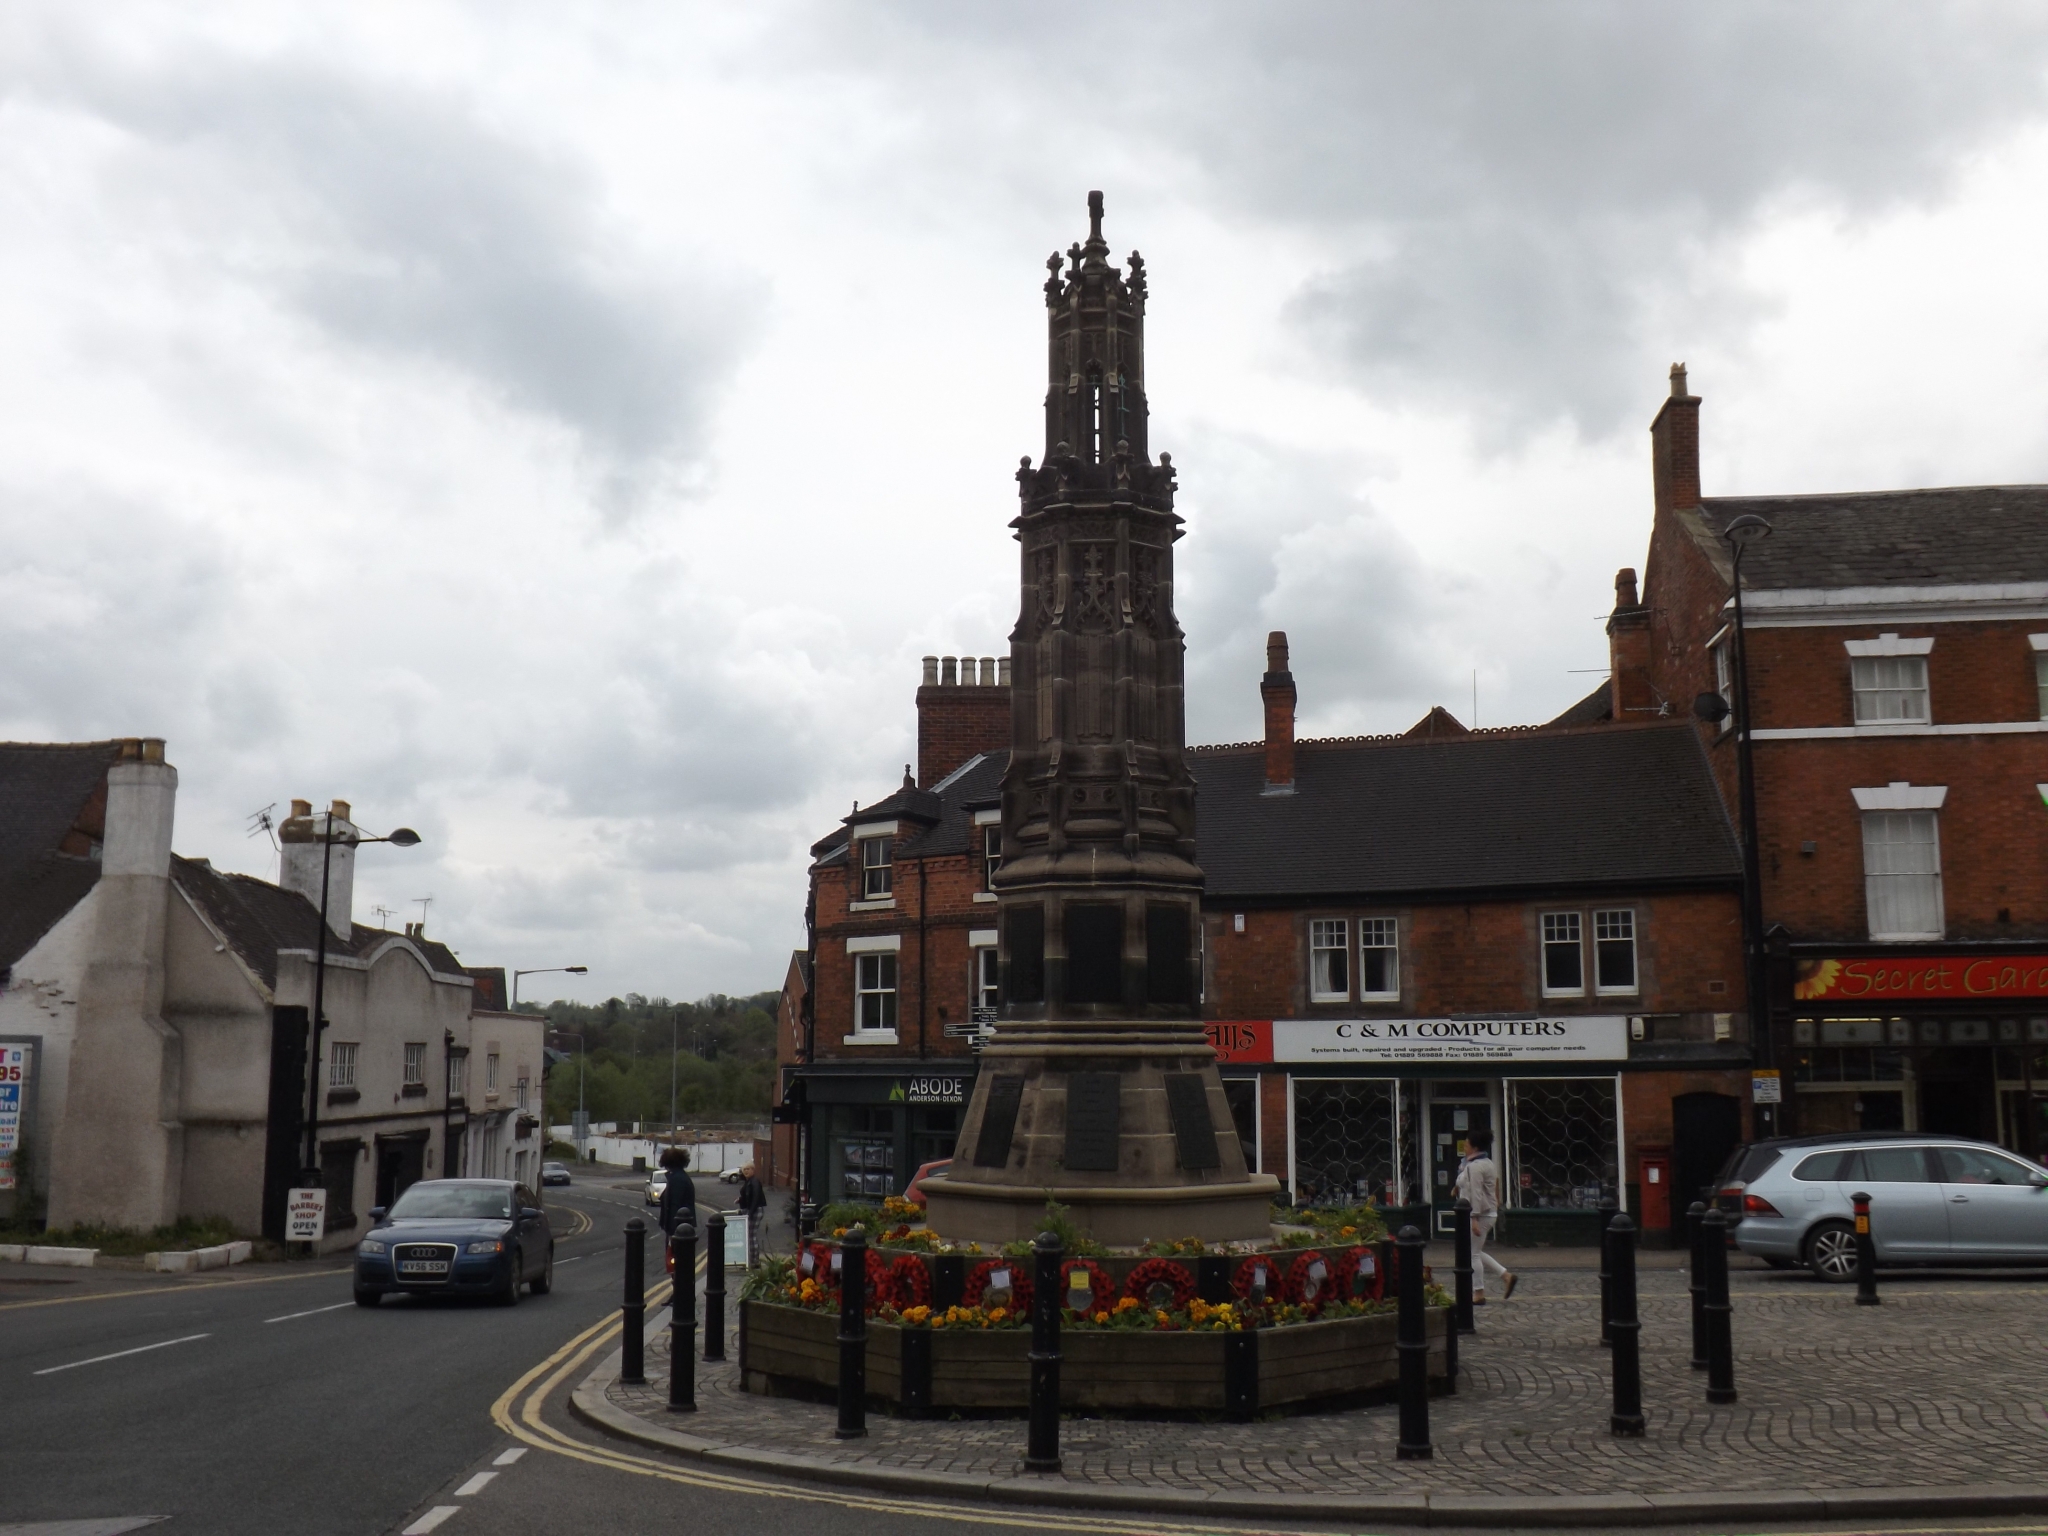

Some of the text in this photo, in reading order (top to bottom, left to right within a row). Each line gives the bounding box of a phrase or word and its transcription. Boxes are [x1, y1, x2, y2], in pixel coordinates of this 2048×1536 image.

[1840, 962, 1953, 996] Secret
[1336, 1021, 1566, 1038] C & M COMPUTERS
[908, 1078, 963, 1095] ABODE
[292, 1221, 318, 1229] OPEN
